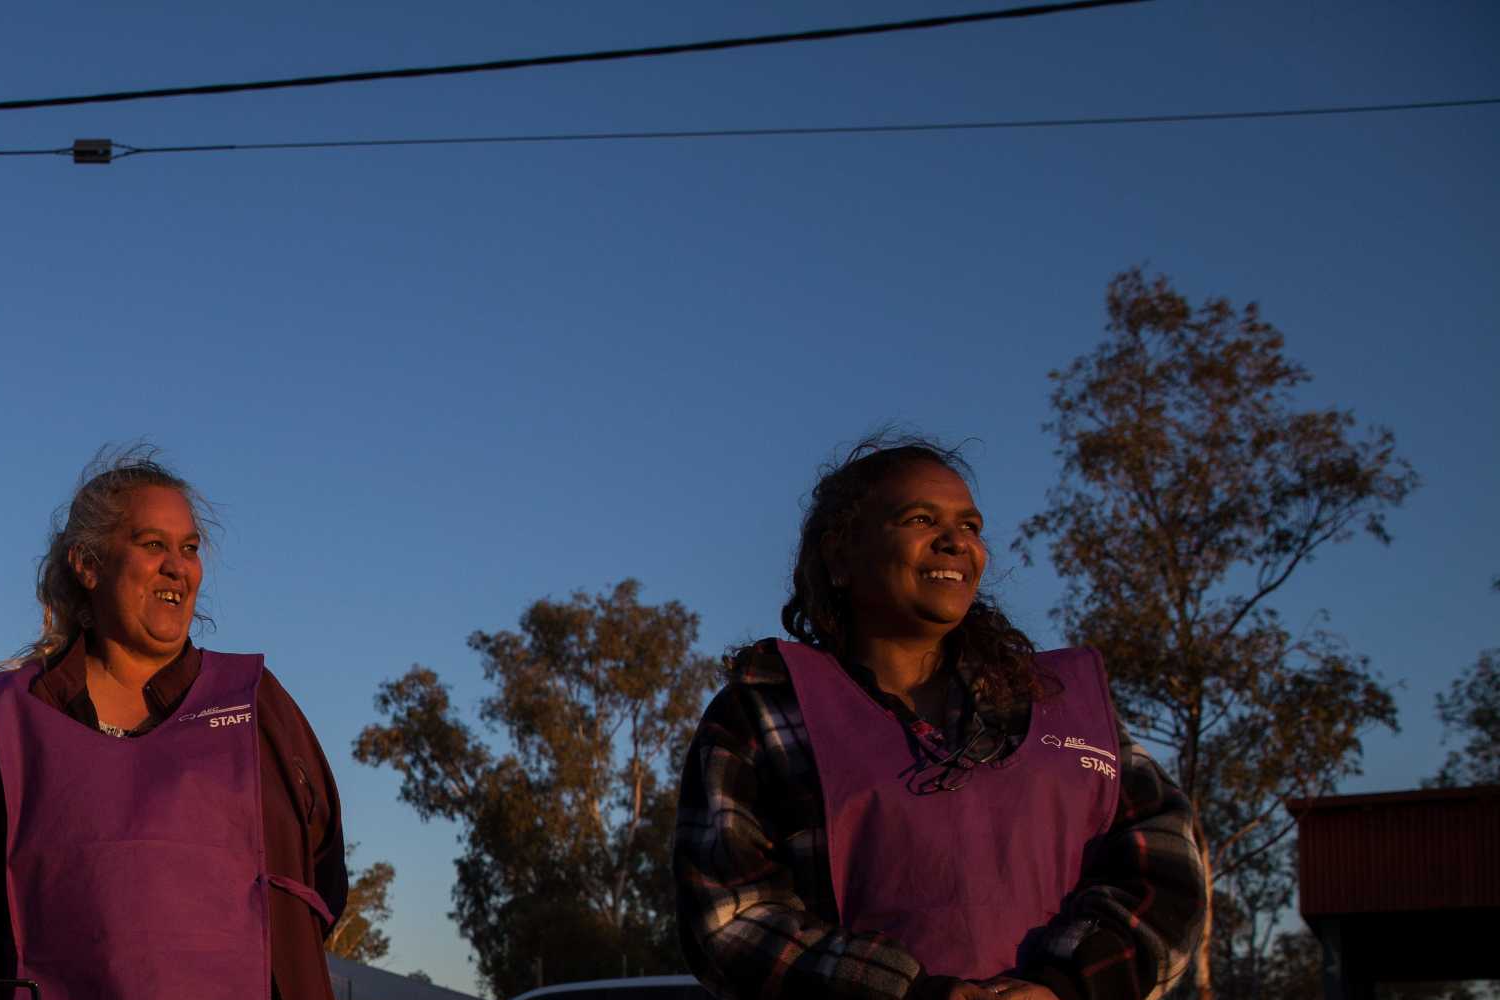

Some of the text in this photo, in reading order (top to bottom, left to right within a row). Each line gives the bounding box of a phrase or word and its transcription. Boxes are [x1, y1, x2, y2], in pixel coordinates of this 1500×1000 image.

[209, 712, 252, 728] STAFF
[1065, 736, 1085, 745] AEC
[1080, 755, 1117, 780] STAFF
